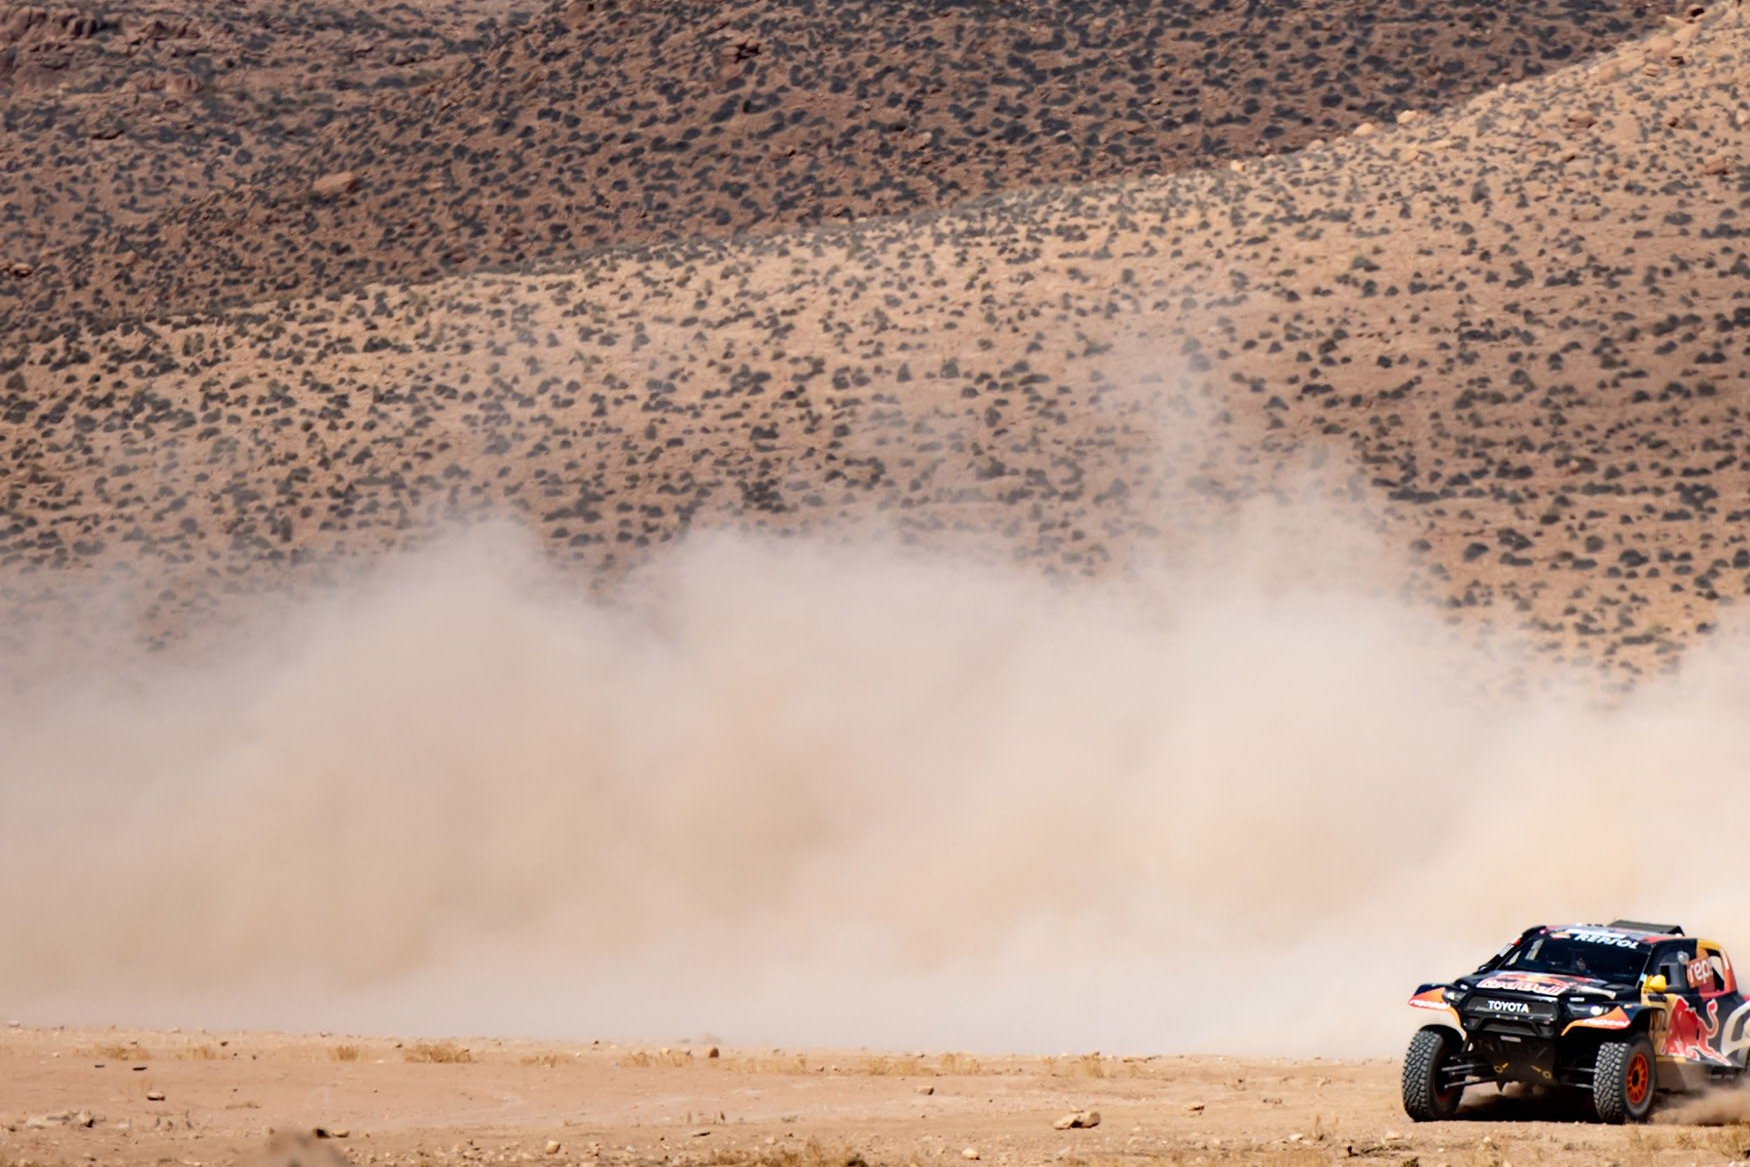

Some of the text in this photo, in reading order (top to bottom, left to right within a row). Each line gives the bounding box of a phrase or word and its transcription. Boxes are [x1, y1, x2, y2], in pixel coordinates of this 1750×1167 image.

[1574, 934, 1639, 949] REPSOL
[1477, 977, 1566, 996] Red Bull
[1488, 1000, 1530, 1013] TOYOTA
